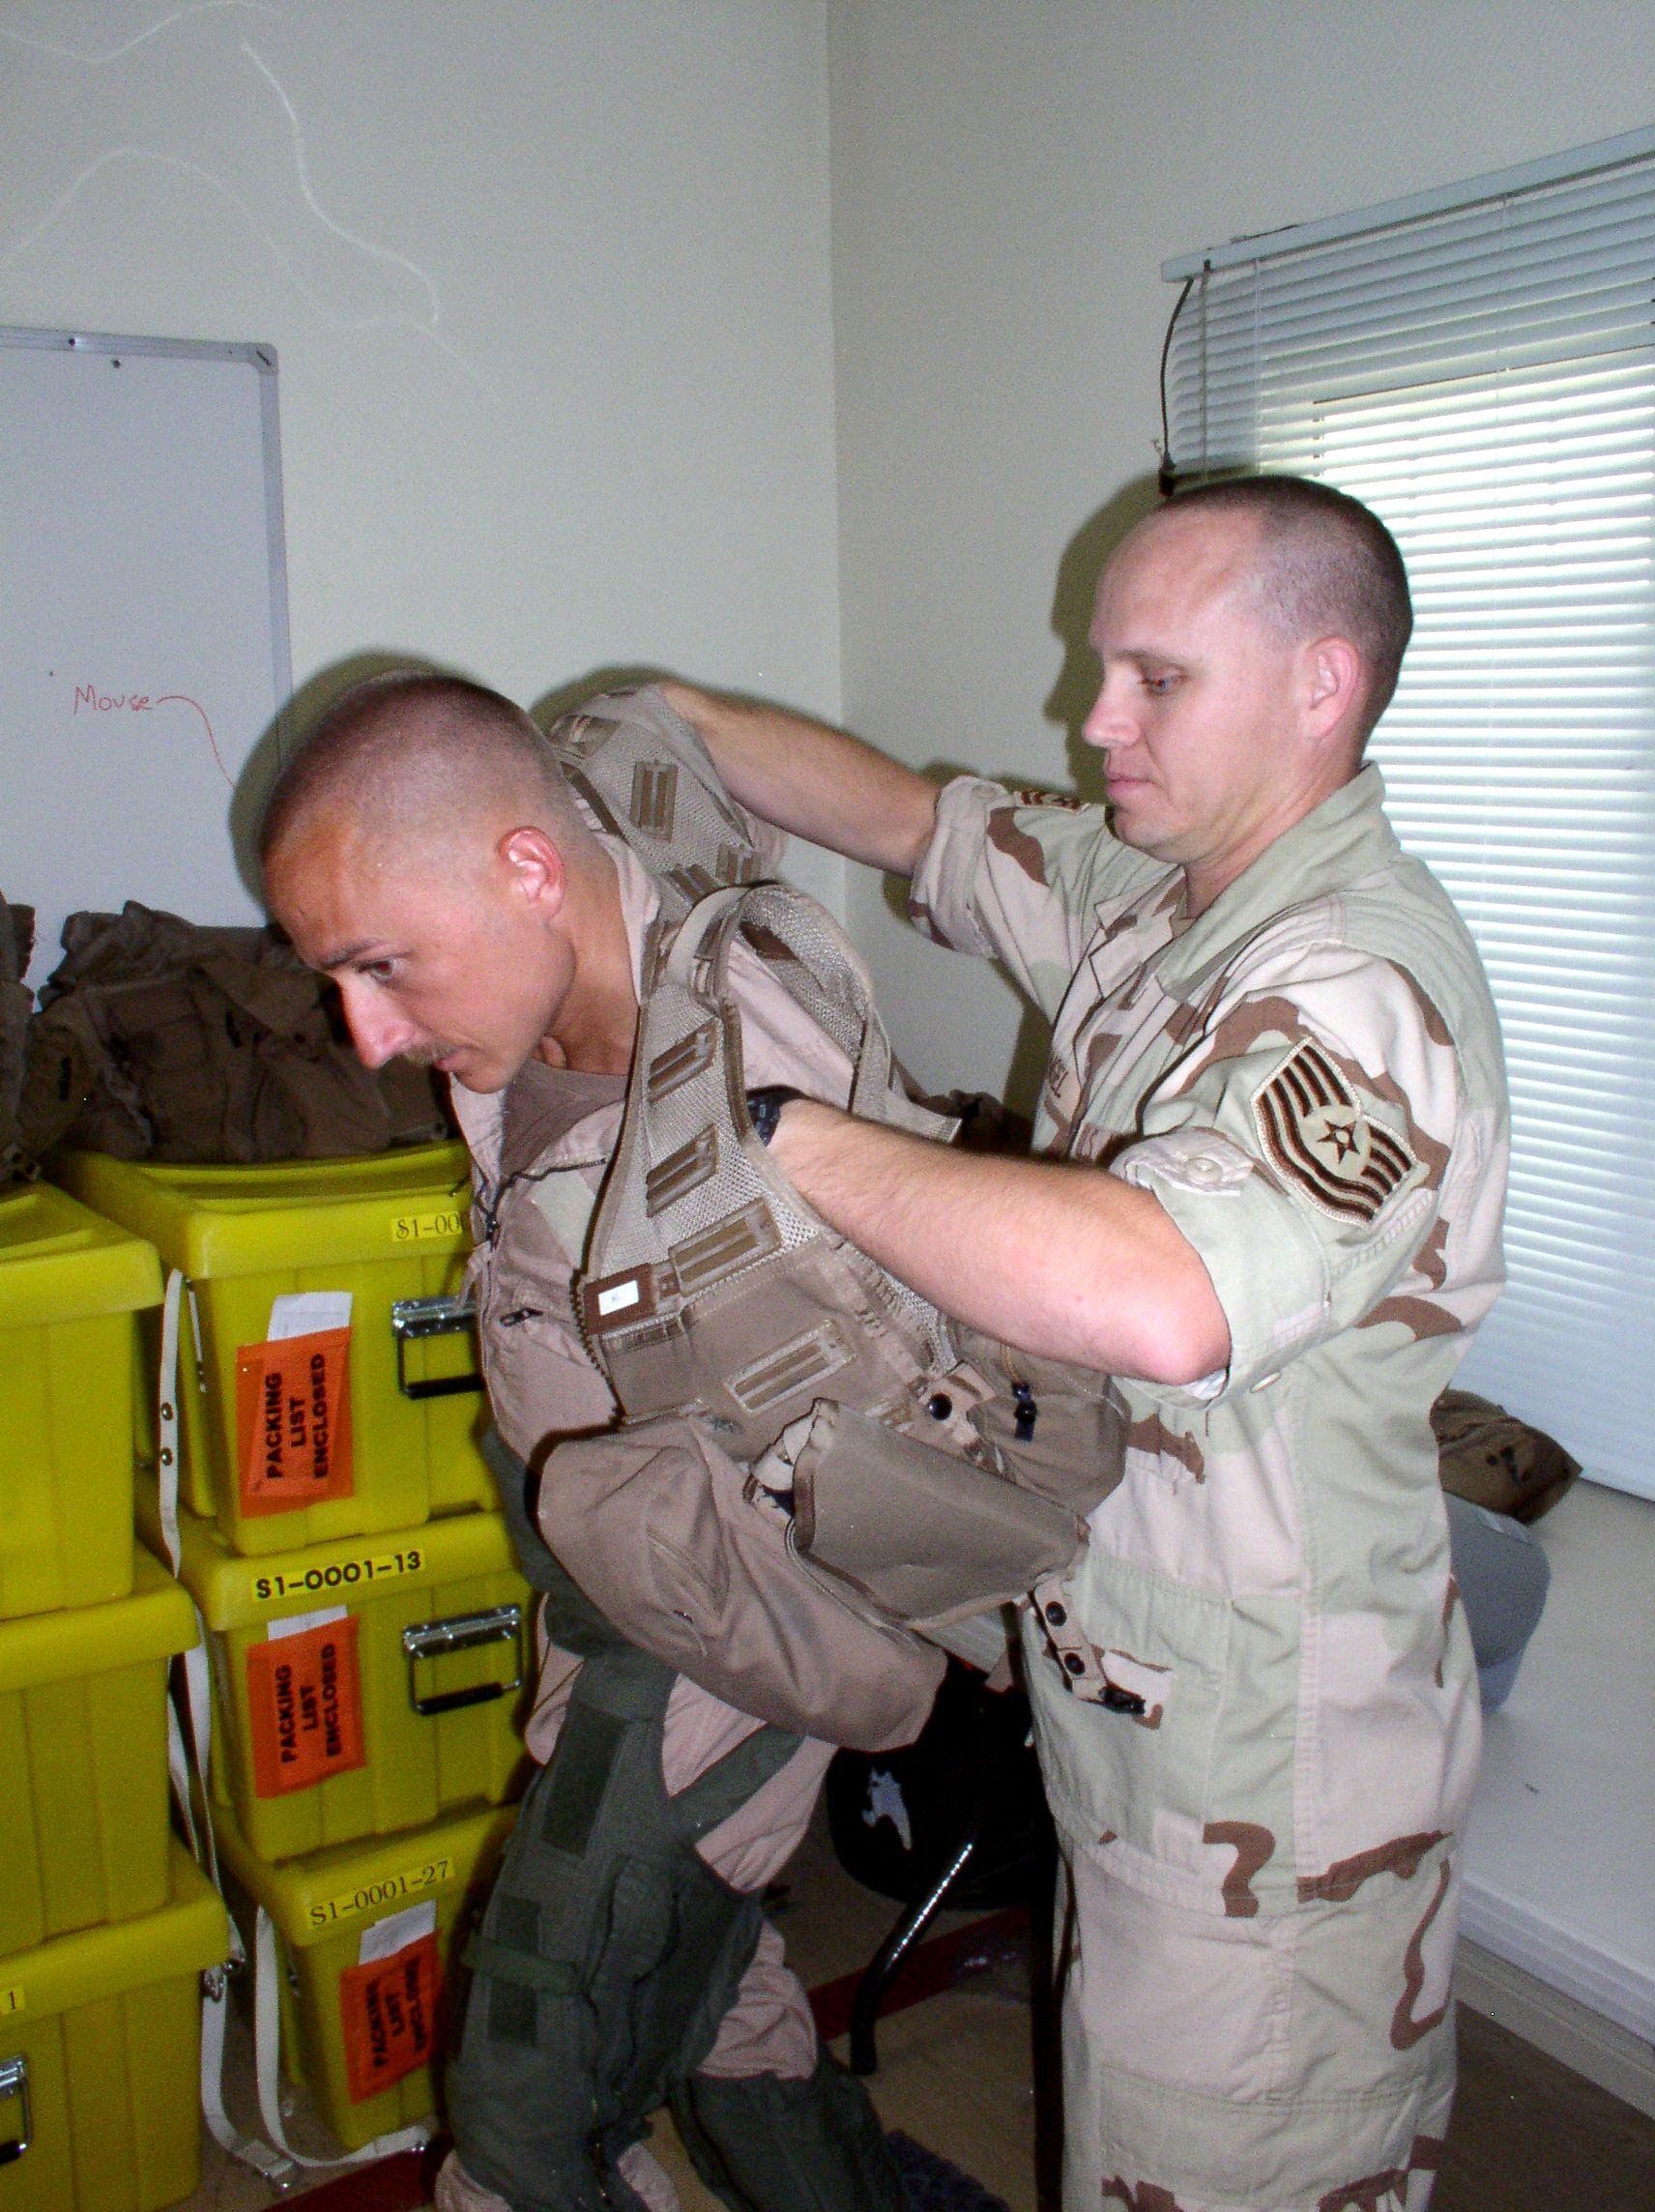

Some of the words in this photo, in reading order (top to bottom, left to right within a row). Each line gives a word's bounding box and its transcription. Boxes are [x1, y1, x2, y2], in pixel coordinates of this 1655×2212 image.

[265, 1372, 283, 1480] PACKING
[290, 1397, 307, 1449] LIST
[309, 1353, 330, 1480] ENCLOSED
[256, 1551, 421, 1599] S1-0001-13
[275, 1664, 296, 1764] PACKING
[300, 1685, 320, 1732] LIST
[321, 1644, 342, 1758] ENCLOSED
[309, 1859, 449, 1926] S1-0001-27
[365, 1980, 388, 2068] PACKING
[386, 1993, 404, 2037] LIST
